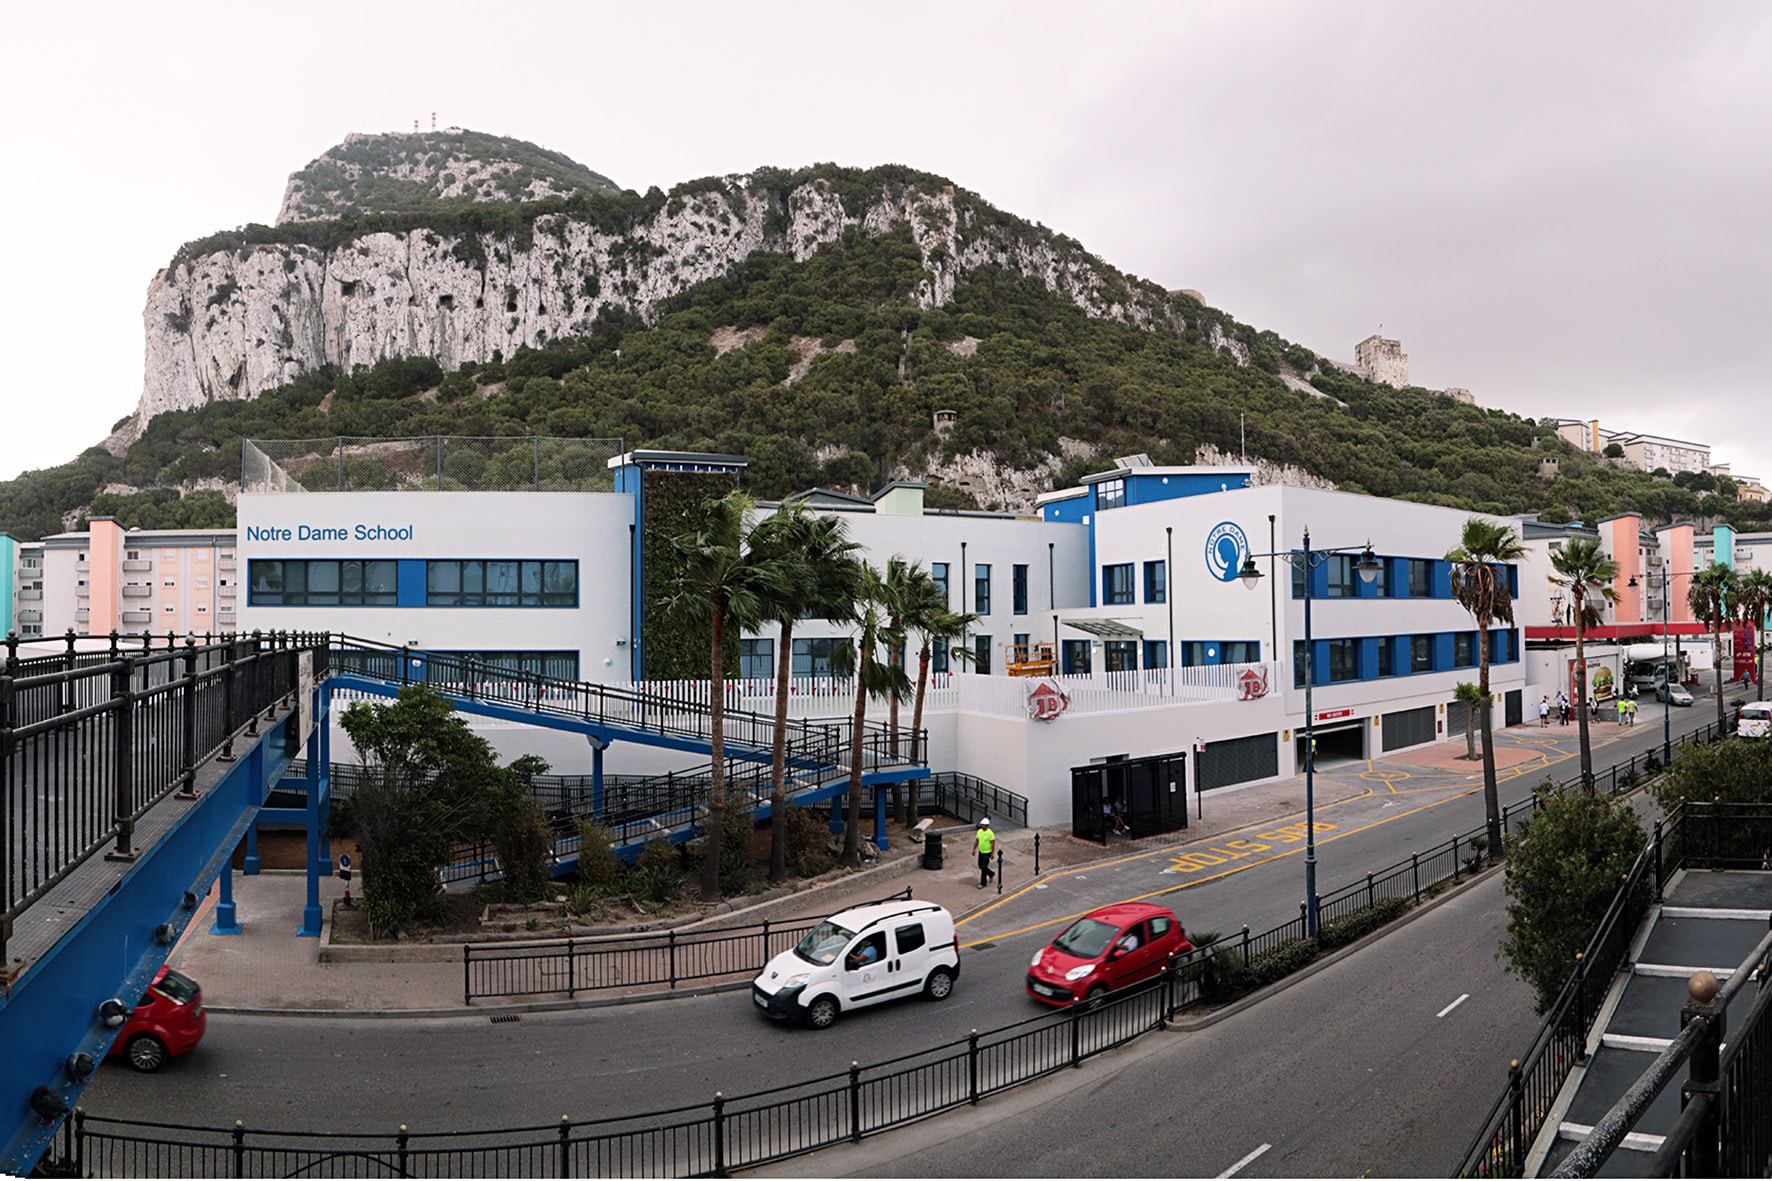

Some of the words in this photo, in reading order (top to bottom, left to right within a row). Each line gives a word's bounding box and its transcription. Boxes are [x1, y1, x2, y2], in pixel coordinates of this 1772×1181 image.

[247, 526, 292, 541] Notre
[298, 525, 349, 541] Dame
[354, 524, 413, 541] School
[1208, 526, 1227, 554] NOTRE
[1229, 526, 1245, 550] DAME
[1169, 840, 1271, 872] STOP
